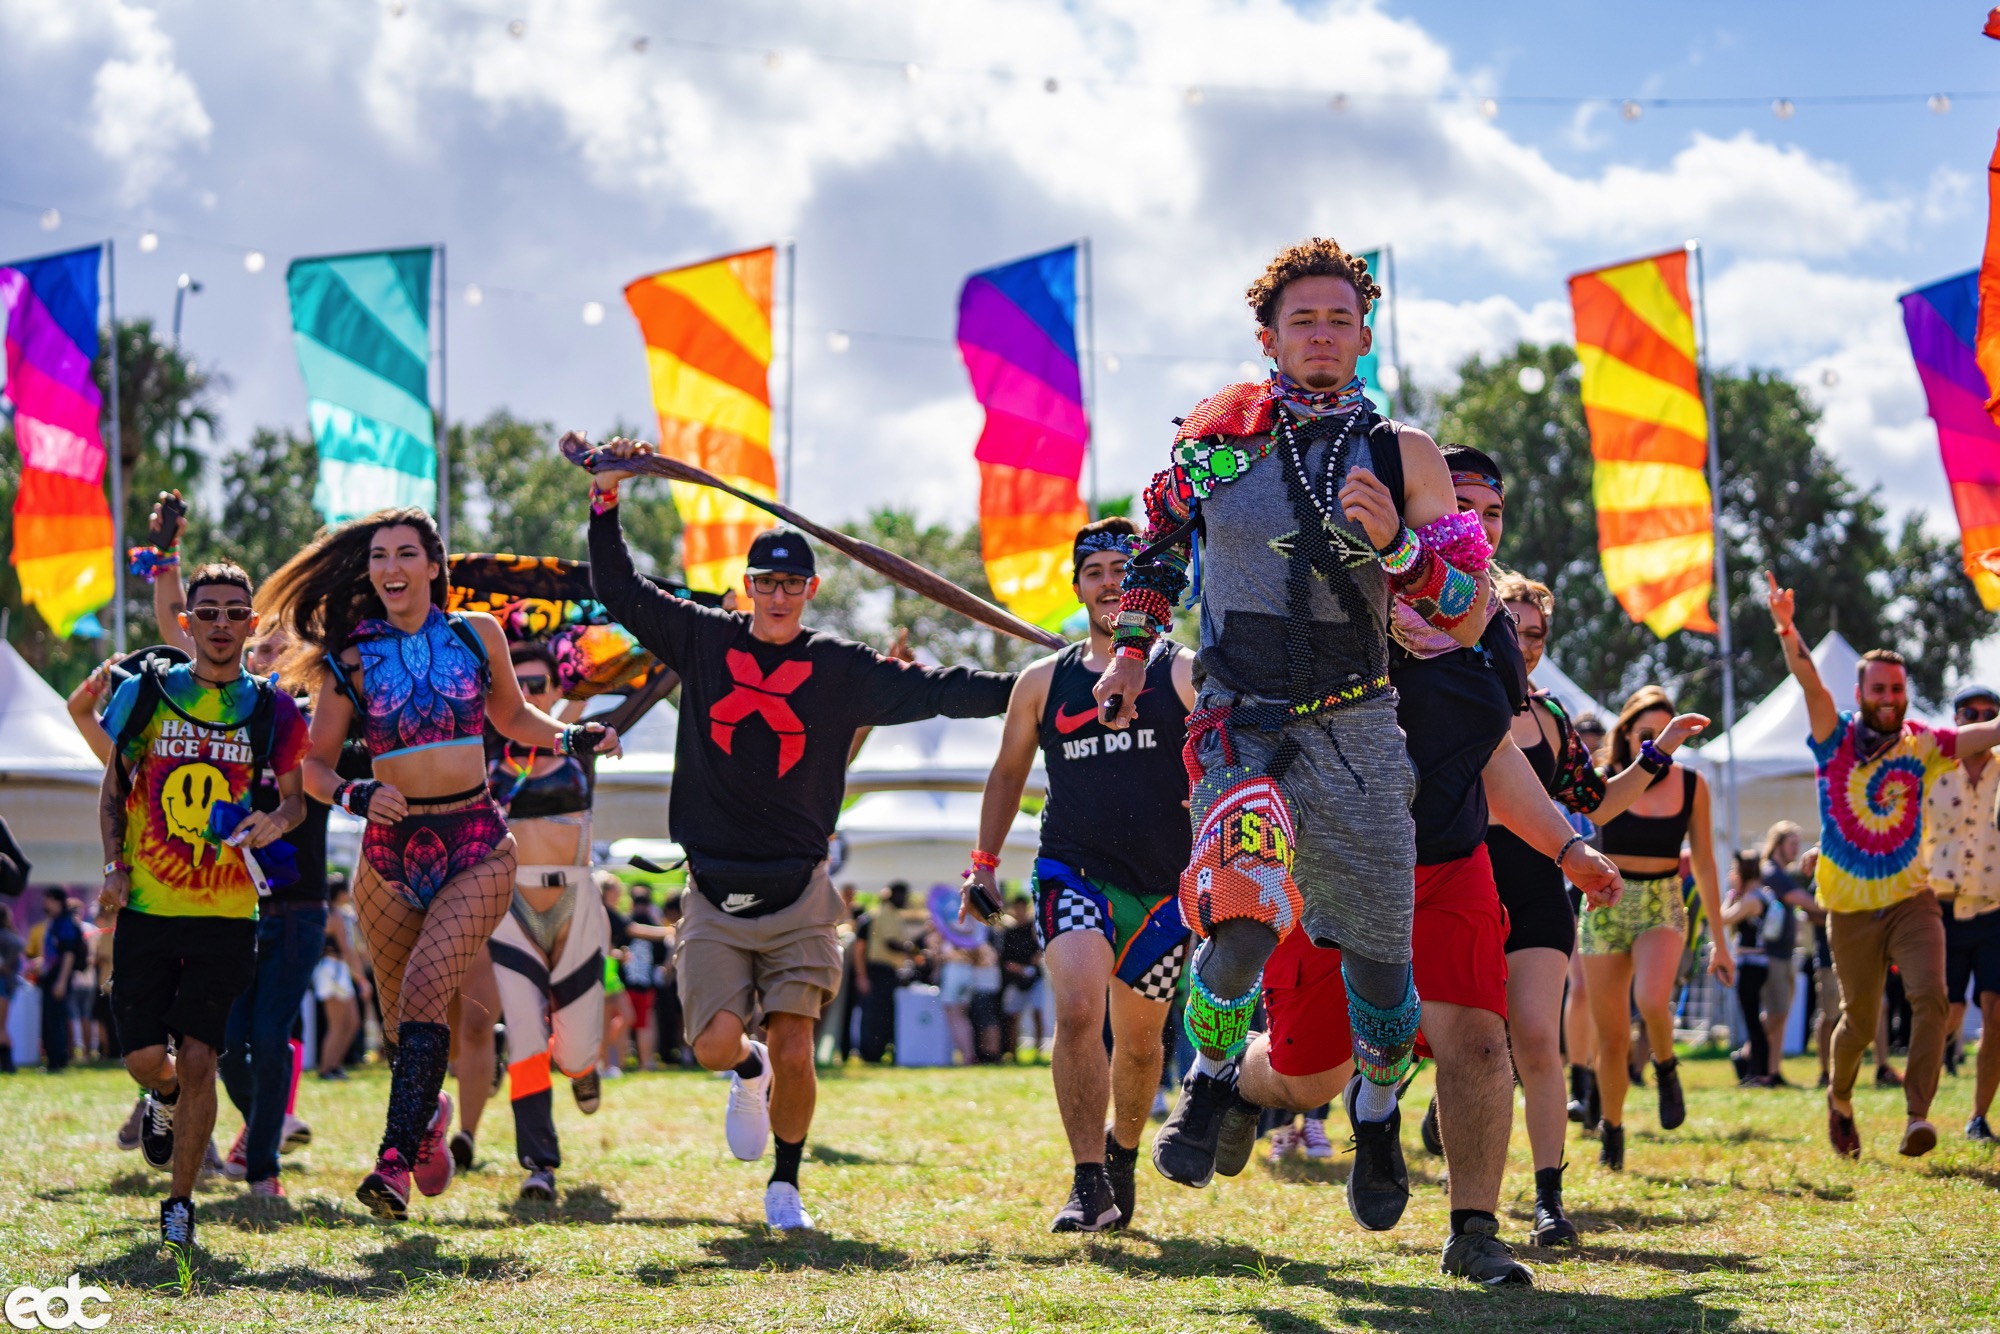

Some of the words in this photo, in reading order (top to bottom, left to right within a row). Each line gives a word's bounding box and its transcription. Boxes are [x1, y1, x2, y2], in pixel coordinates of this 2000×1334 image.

[161, 719, 226, 741] HAVE
[233, 726, 251, 743] A
[152, 738, 200, 758] NICE
[1062, 736, 1099, 760] JUST
[1103, 731, 1132, 753] DO
[1137, 728, 1157, 749] IT.
[726, 893, 755, 906] NIKE
